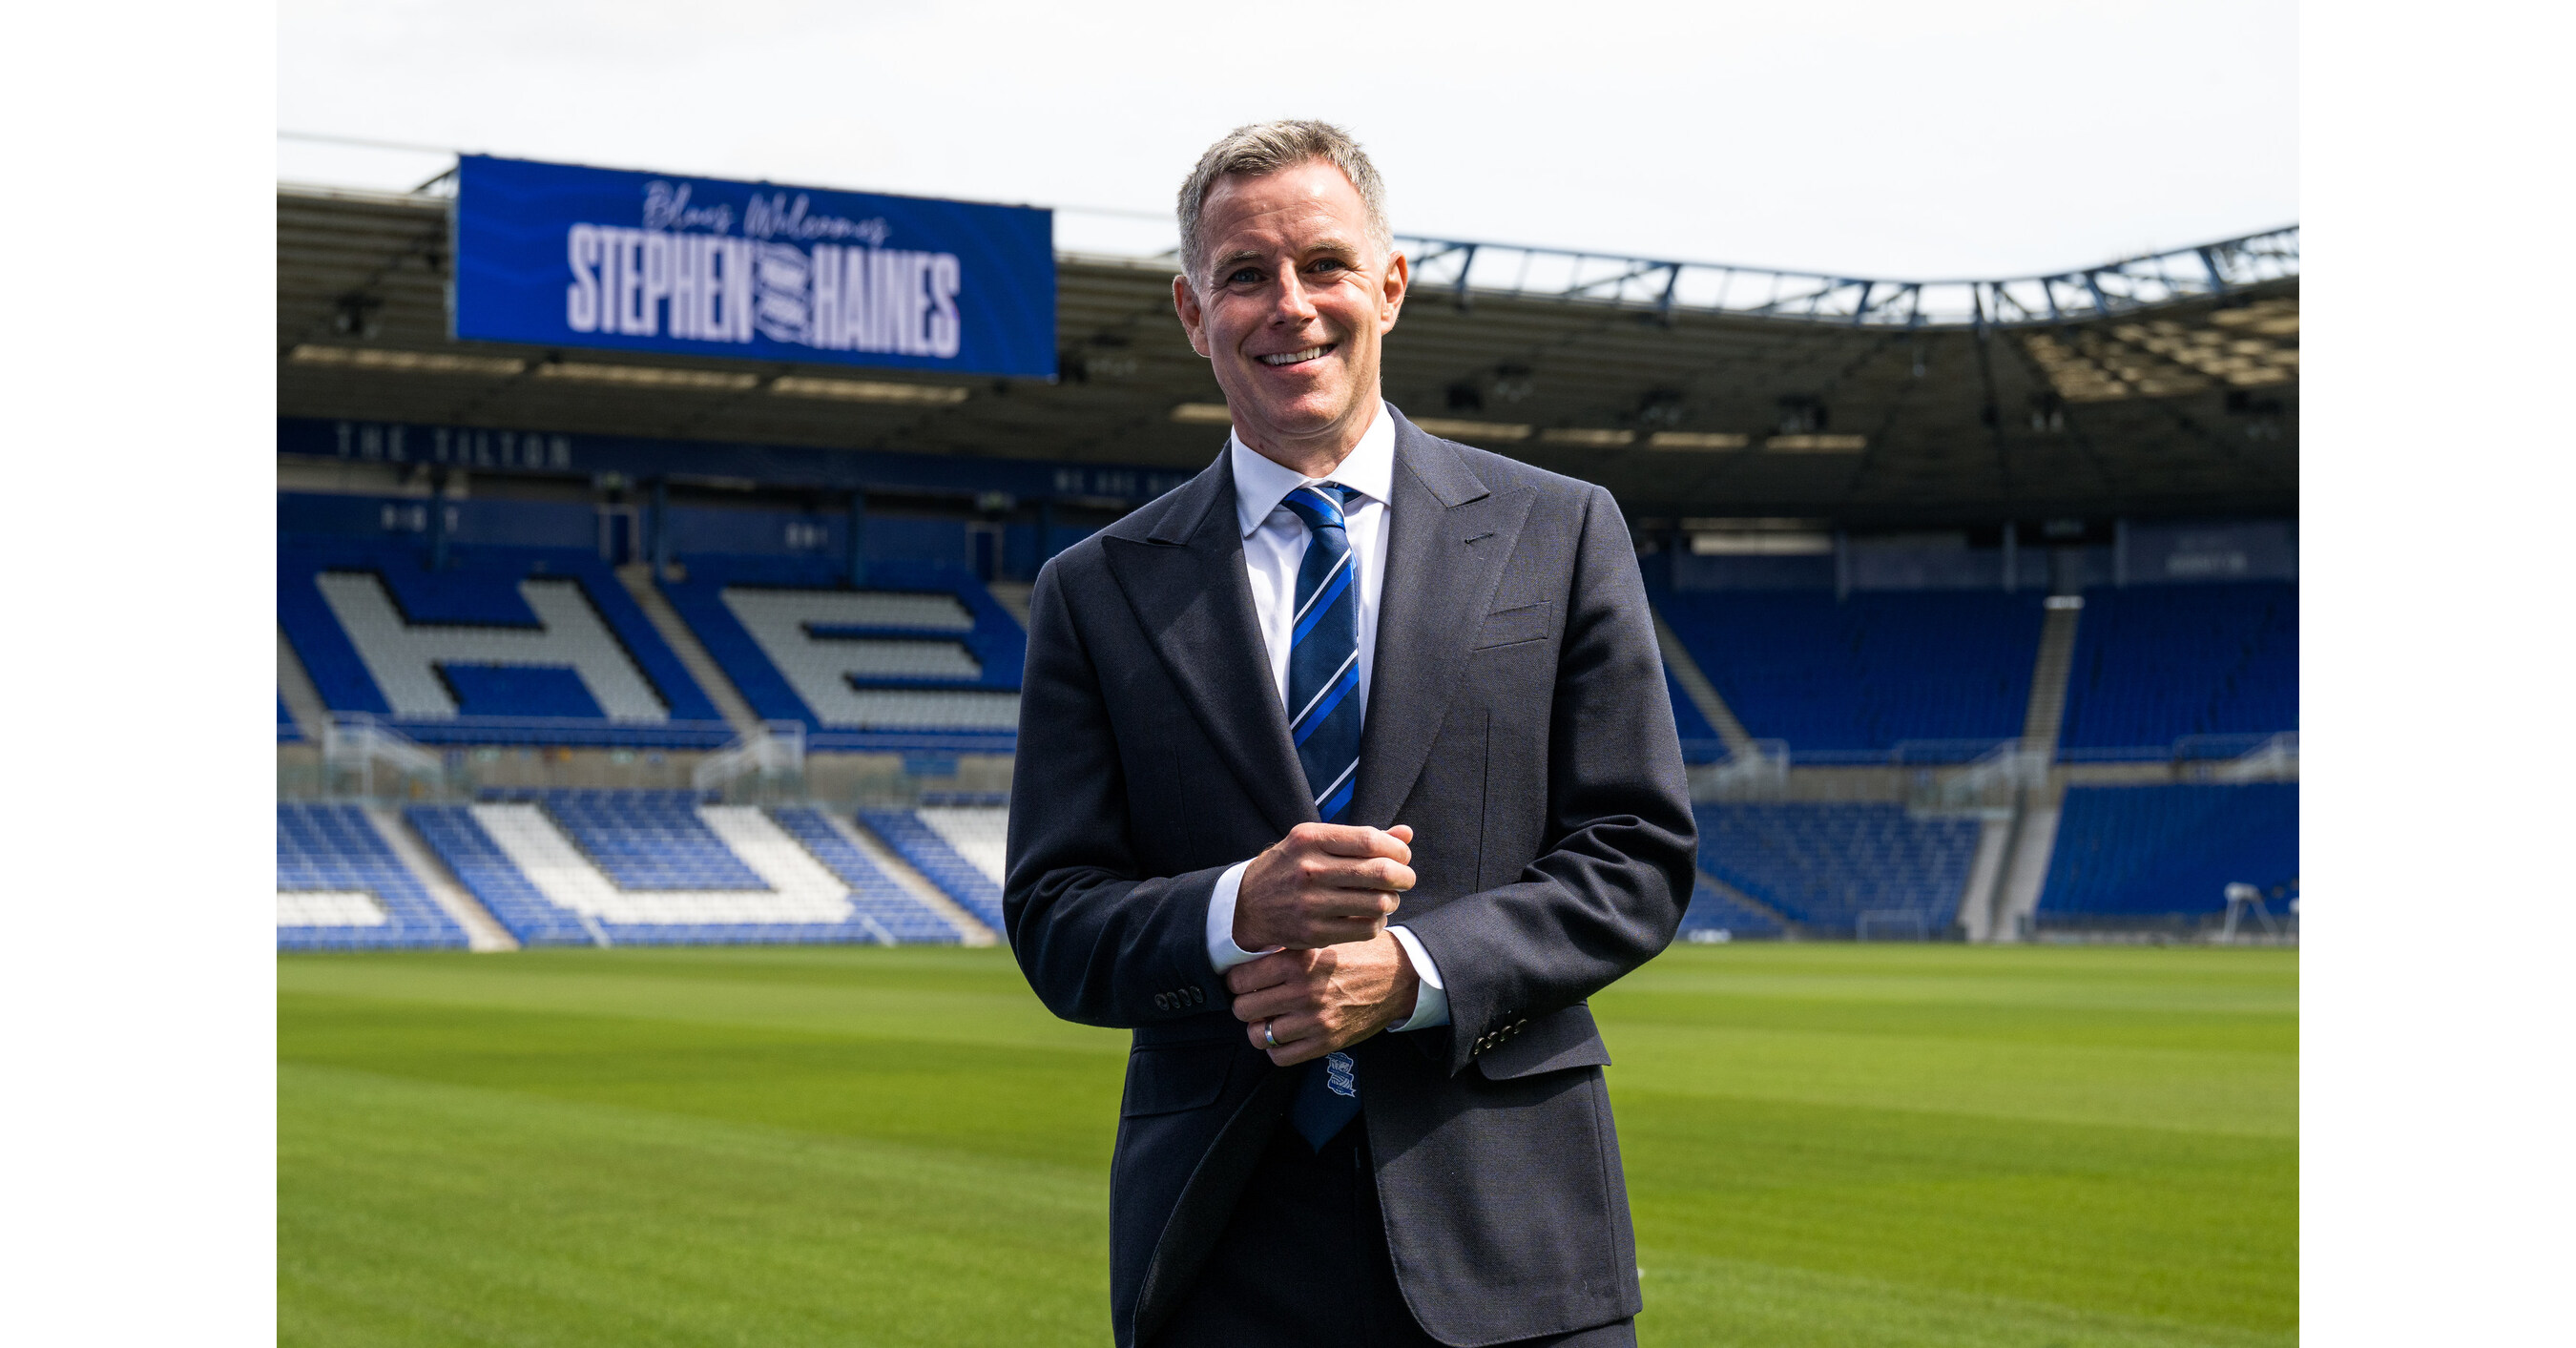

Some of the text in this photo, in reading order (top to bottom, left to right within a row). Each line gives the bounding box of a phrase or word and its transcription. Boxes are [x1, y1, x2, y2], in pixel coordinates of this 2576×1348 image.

[568, 223, 961, 359] STEPHEN HAINES
[336, 422, 572, 471] THE TILTON
